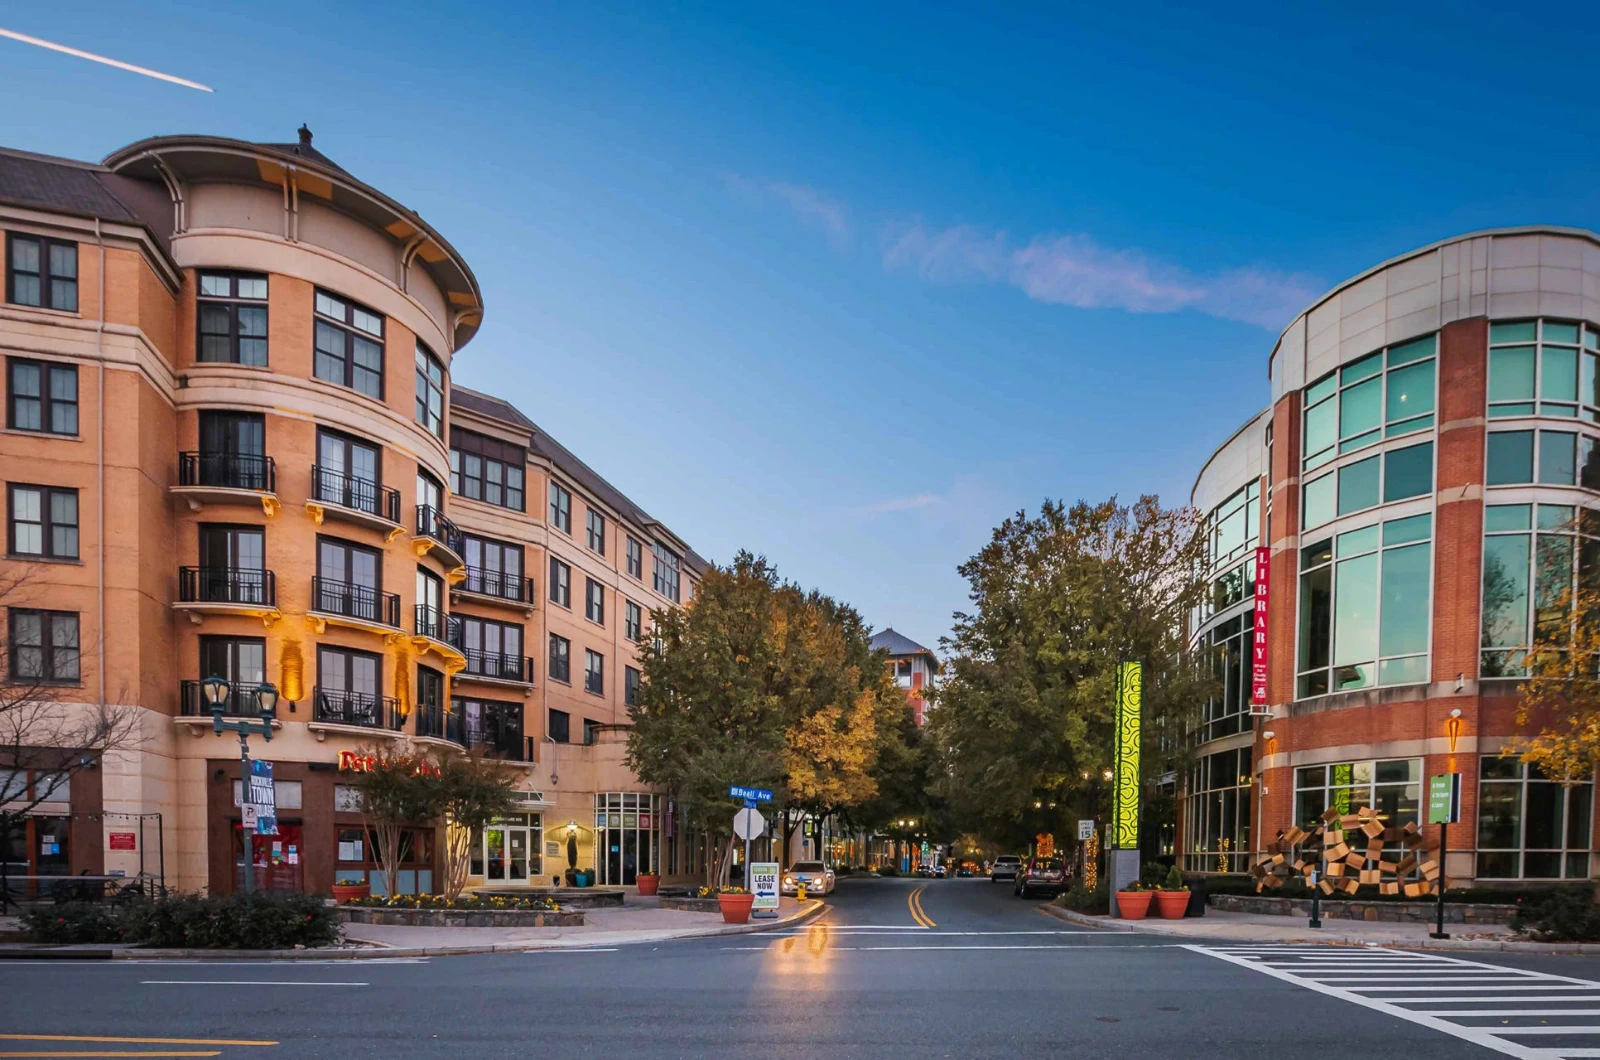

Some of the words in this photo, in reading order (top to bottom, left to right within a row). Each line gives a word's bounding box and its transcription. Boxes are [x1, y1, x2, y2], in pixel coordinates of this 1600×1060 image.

[1256, 552, 1268, 659] LIBRARY
[252, 786, 274, 805] TOWN
[738, 788, 755, 798] Beall
[757, 791, 771, 800] Ave
[256, 804, 276, 818] QUARE
[1081, 831, 1091, 839] 15
[754, 875, 775, 883] LEASE
[757, 882, 773, 890] NOW
